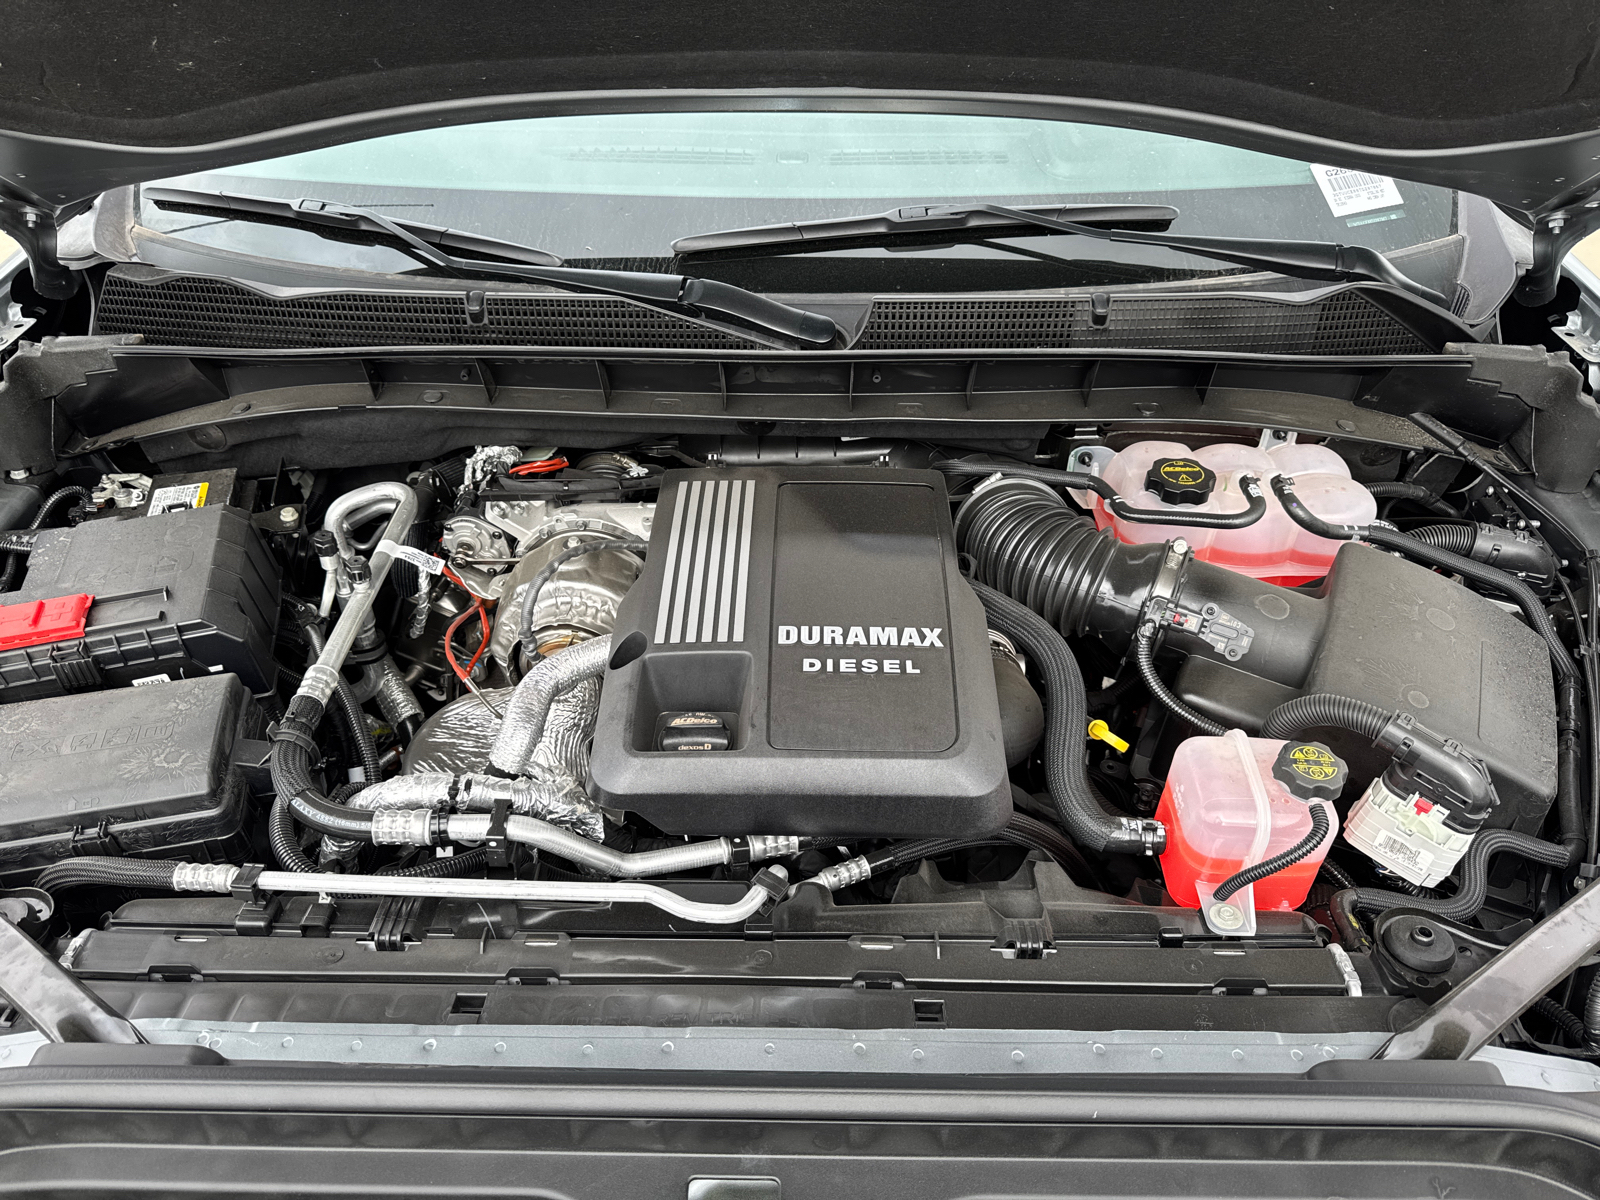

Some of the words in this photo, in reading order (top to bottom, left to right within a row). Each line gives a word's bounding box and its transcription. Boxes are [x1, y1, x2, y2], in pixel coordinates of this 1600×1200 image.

[1325, 168, 1353, 177] G26
[777, 625, 944, 648] DURAMAX
[802, 658, 921, 674] DIESEL
[670, 717, 718, 726] ACDelco
